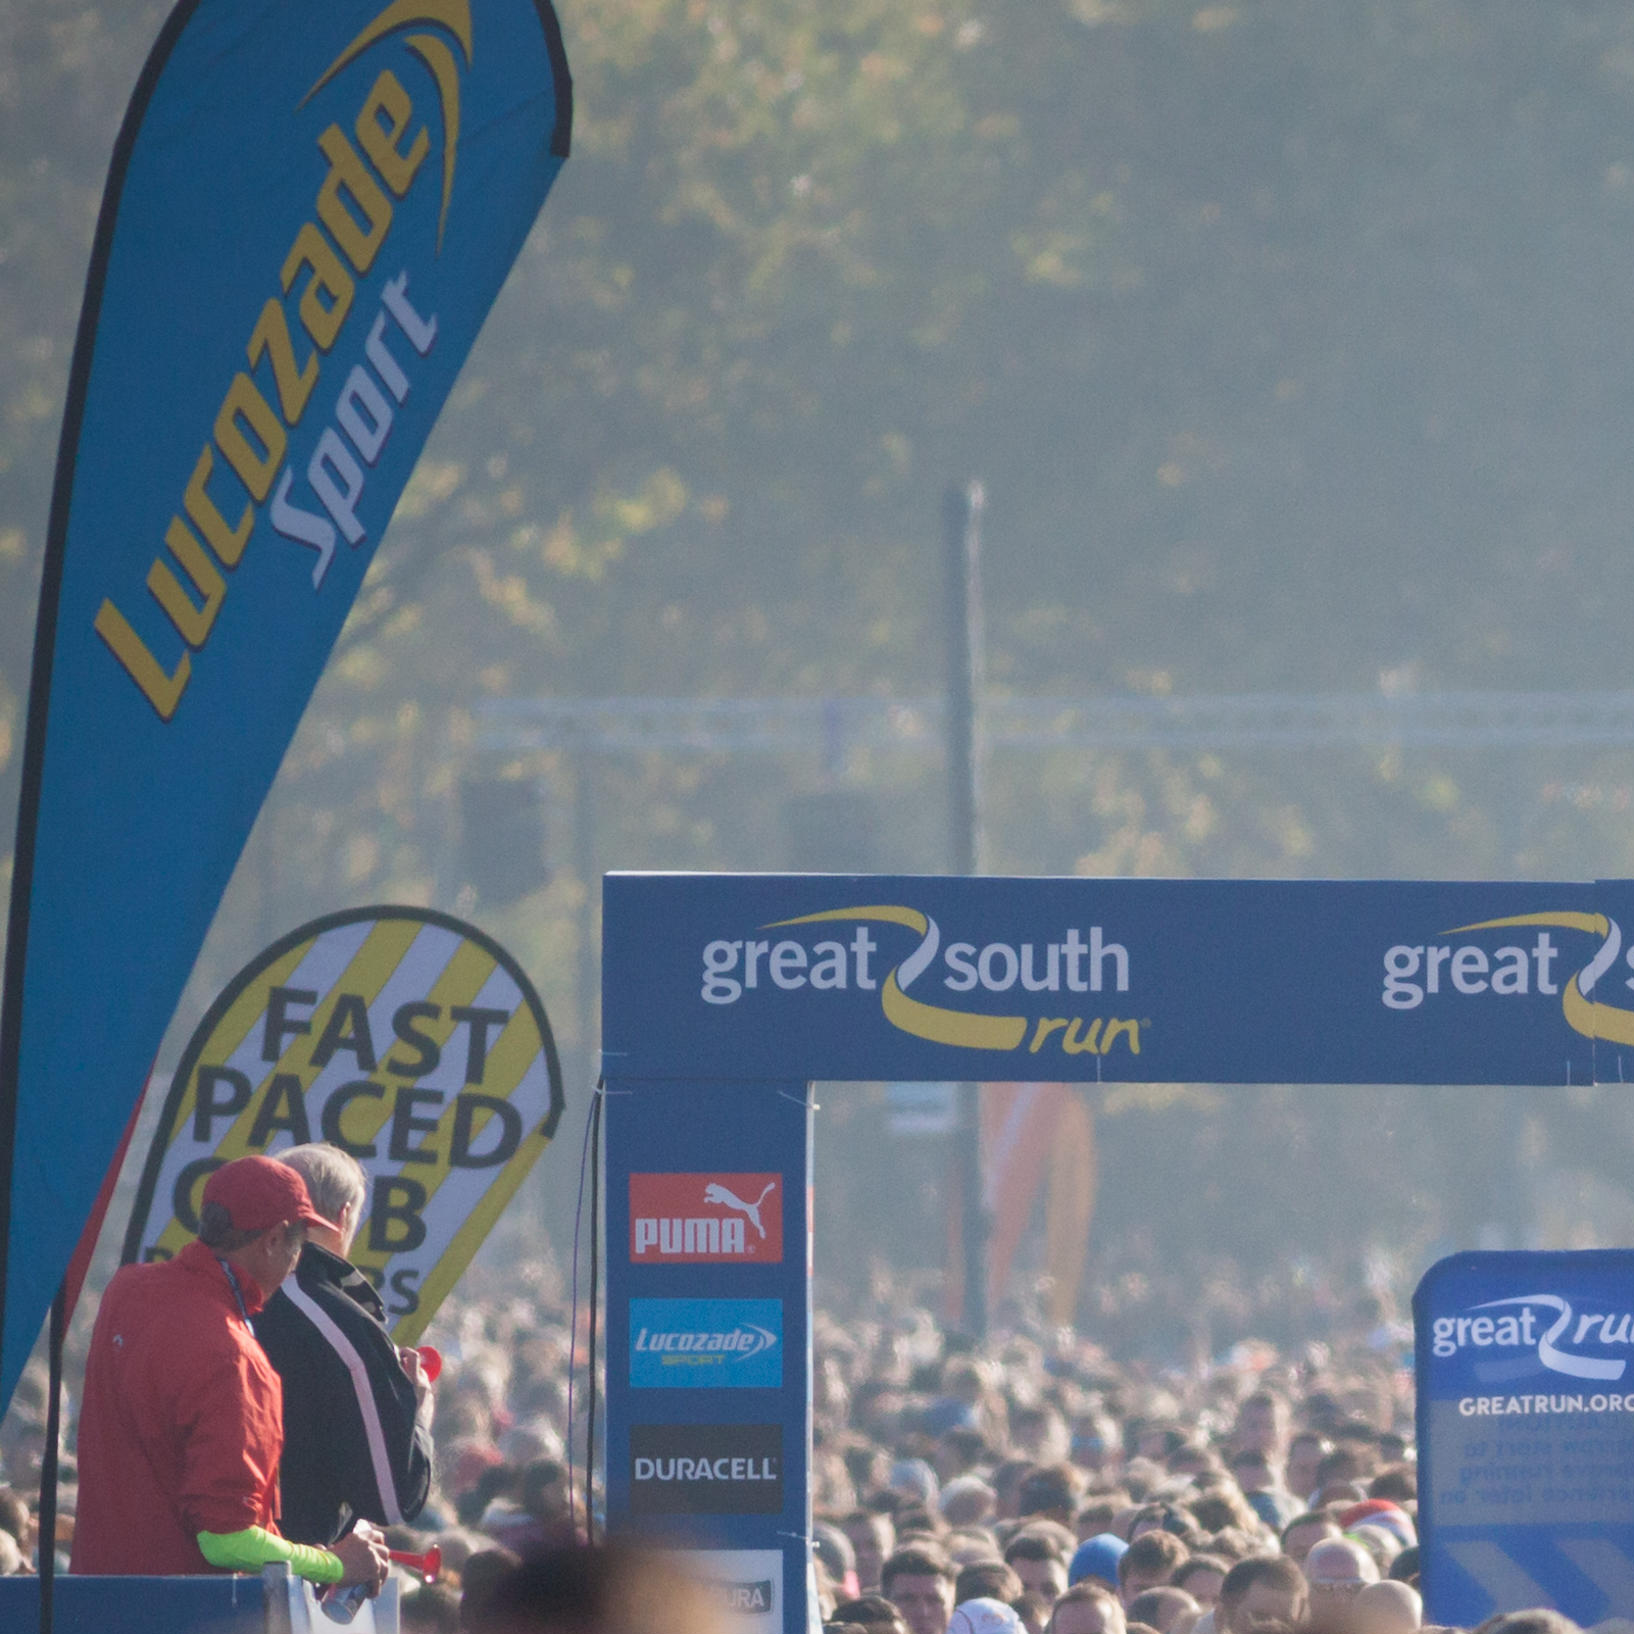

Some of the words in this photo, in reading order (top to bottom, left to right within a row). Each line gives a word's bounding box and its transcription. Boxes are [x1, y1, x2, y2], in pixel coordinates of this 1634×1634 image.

[270, 272, 437, 588] Sport
[702, 927, 876, 1005] great
[945, 927, 1129, 992] south
[1382, 932, 1558, 1010] great
[261, 986, 510, 1085] FAST
[1029, 1016, 1141, 1055] run
[193, 1064, 523, 1169] PACED
[173, 1156, 427, 1252] CB
[634, 1217, 745, 1254] PUMA
[1432, 1306, 1537, 1358] great
[635, 1457, 777, 1482] DURACELL
